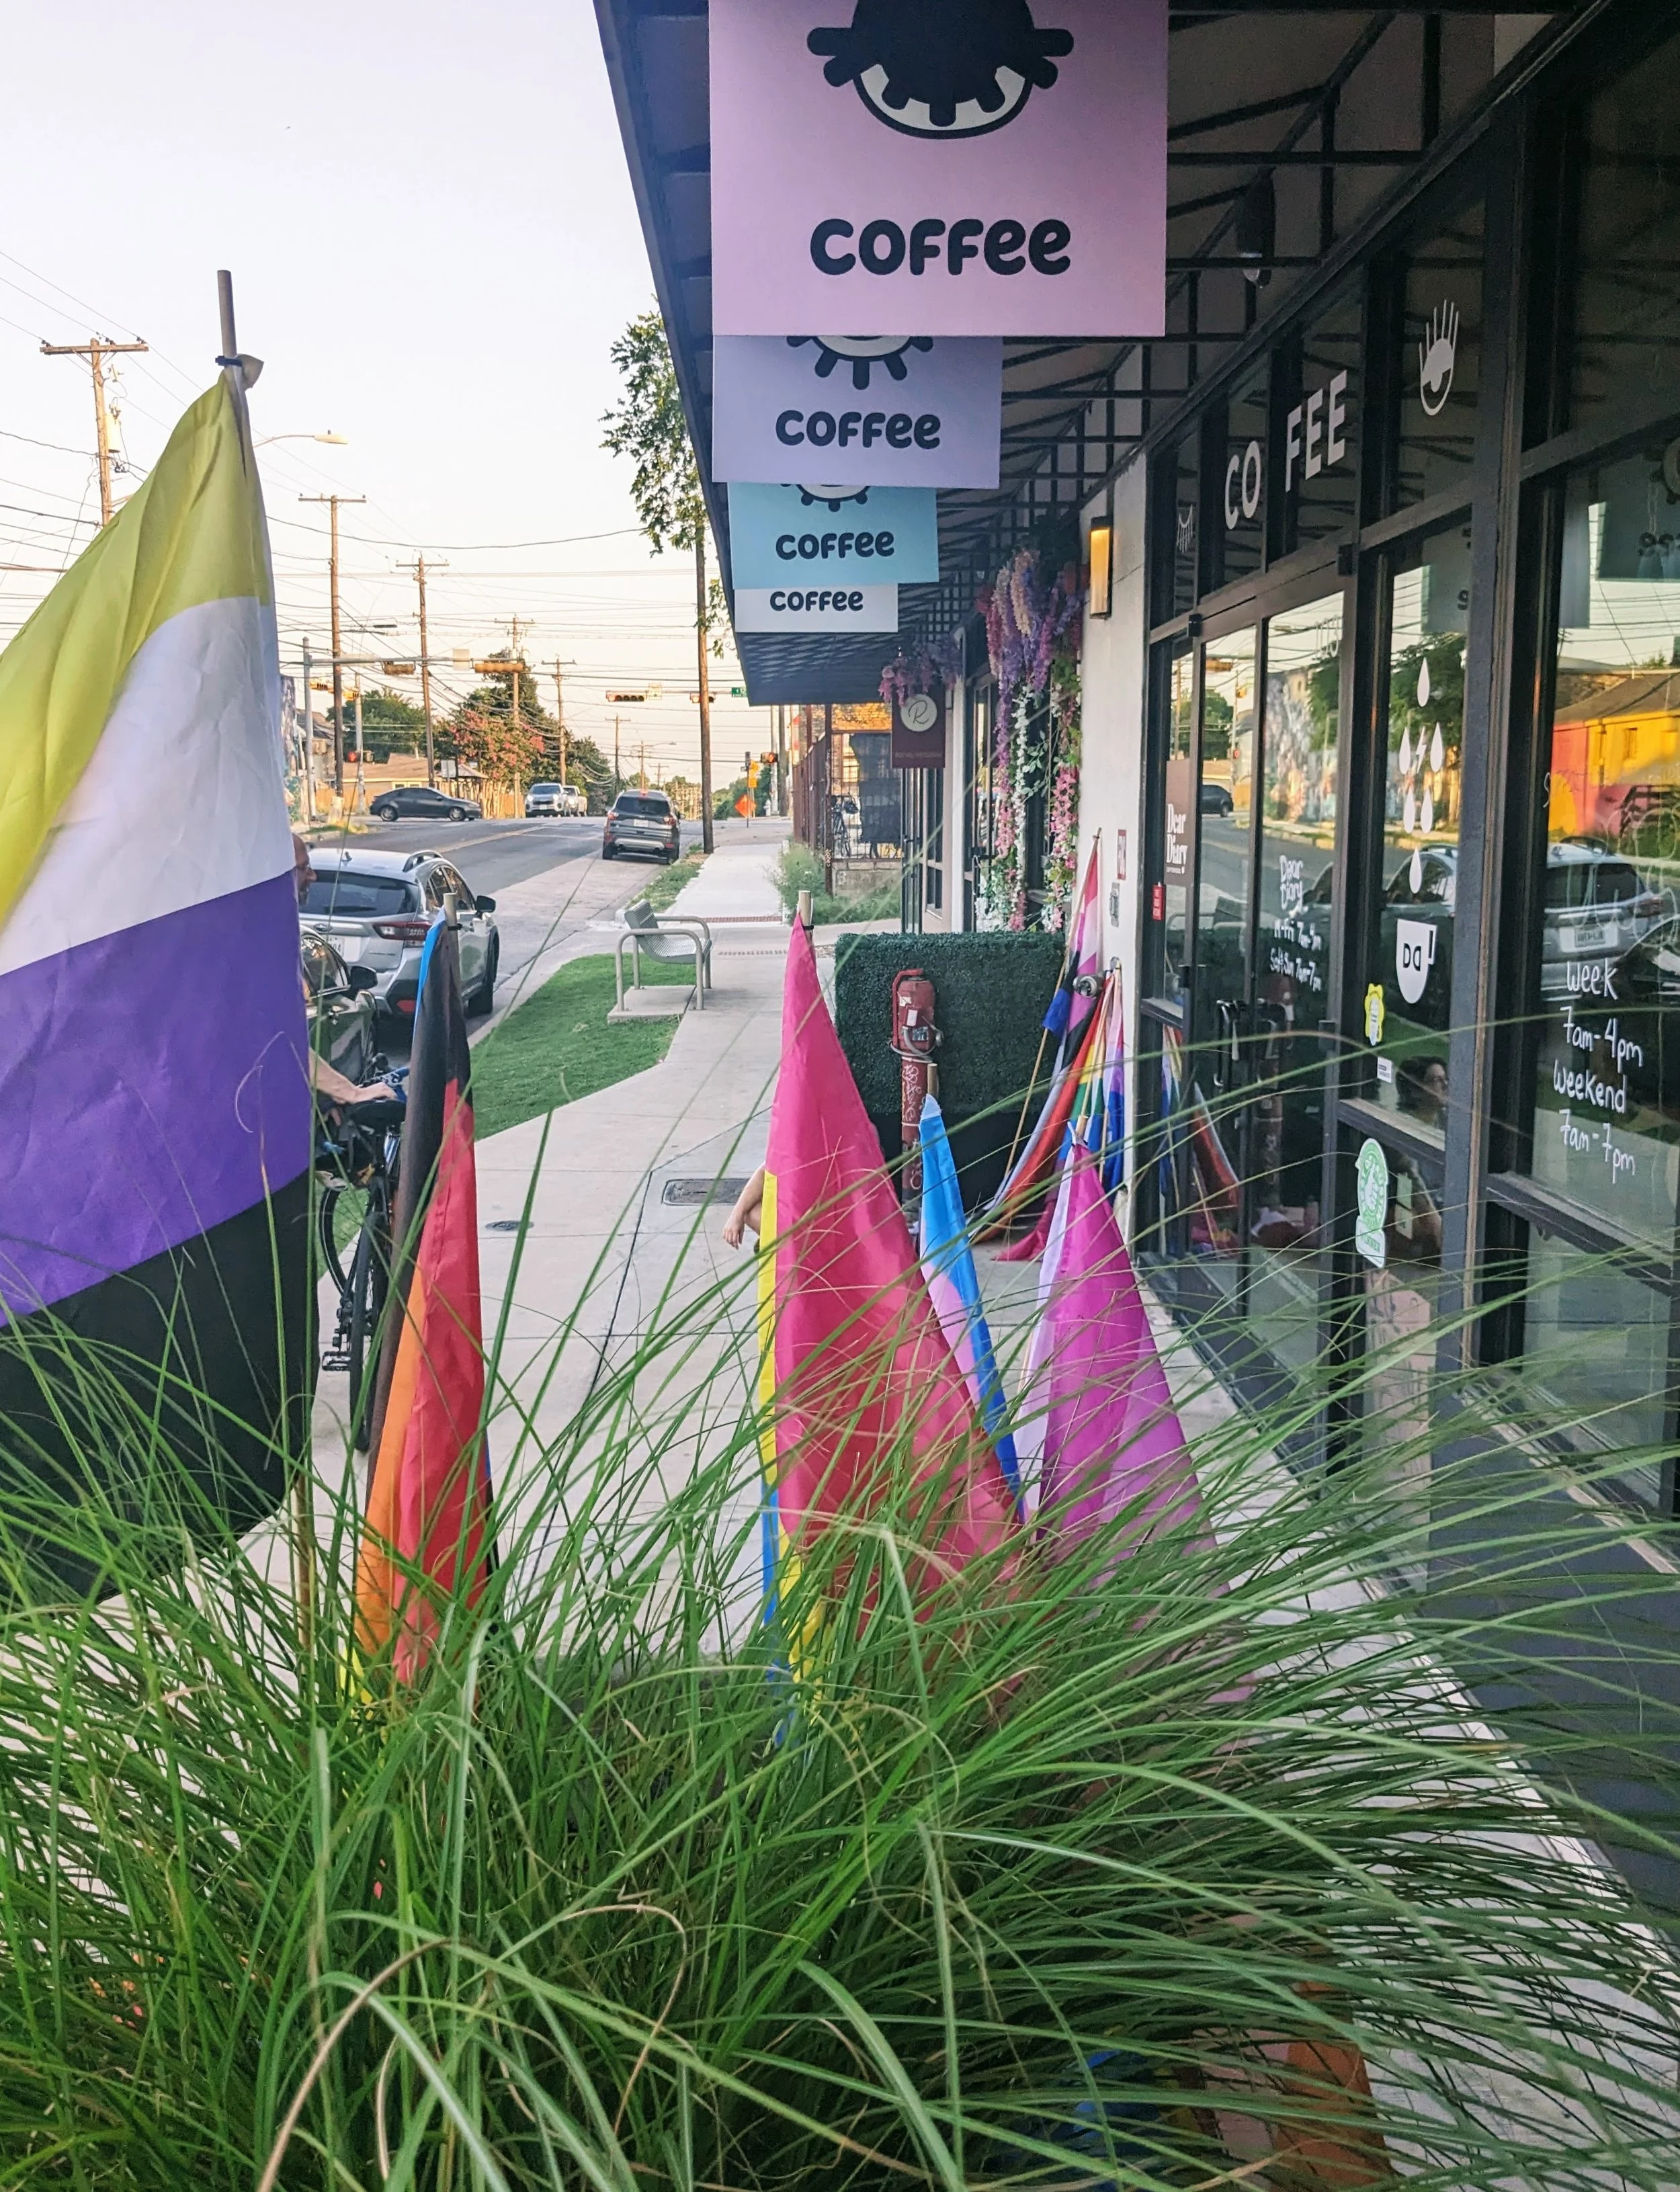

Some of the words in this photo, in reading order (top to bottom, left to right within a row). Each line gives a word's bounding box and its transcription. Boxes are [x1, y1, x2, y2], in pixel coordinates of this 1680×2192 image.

[908, 700, 929, 724] R
[1167, 803, 1186, 834] Dear
[1279, 855, 1304, 883] Dear
